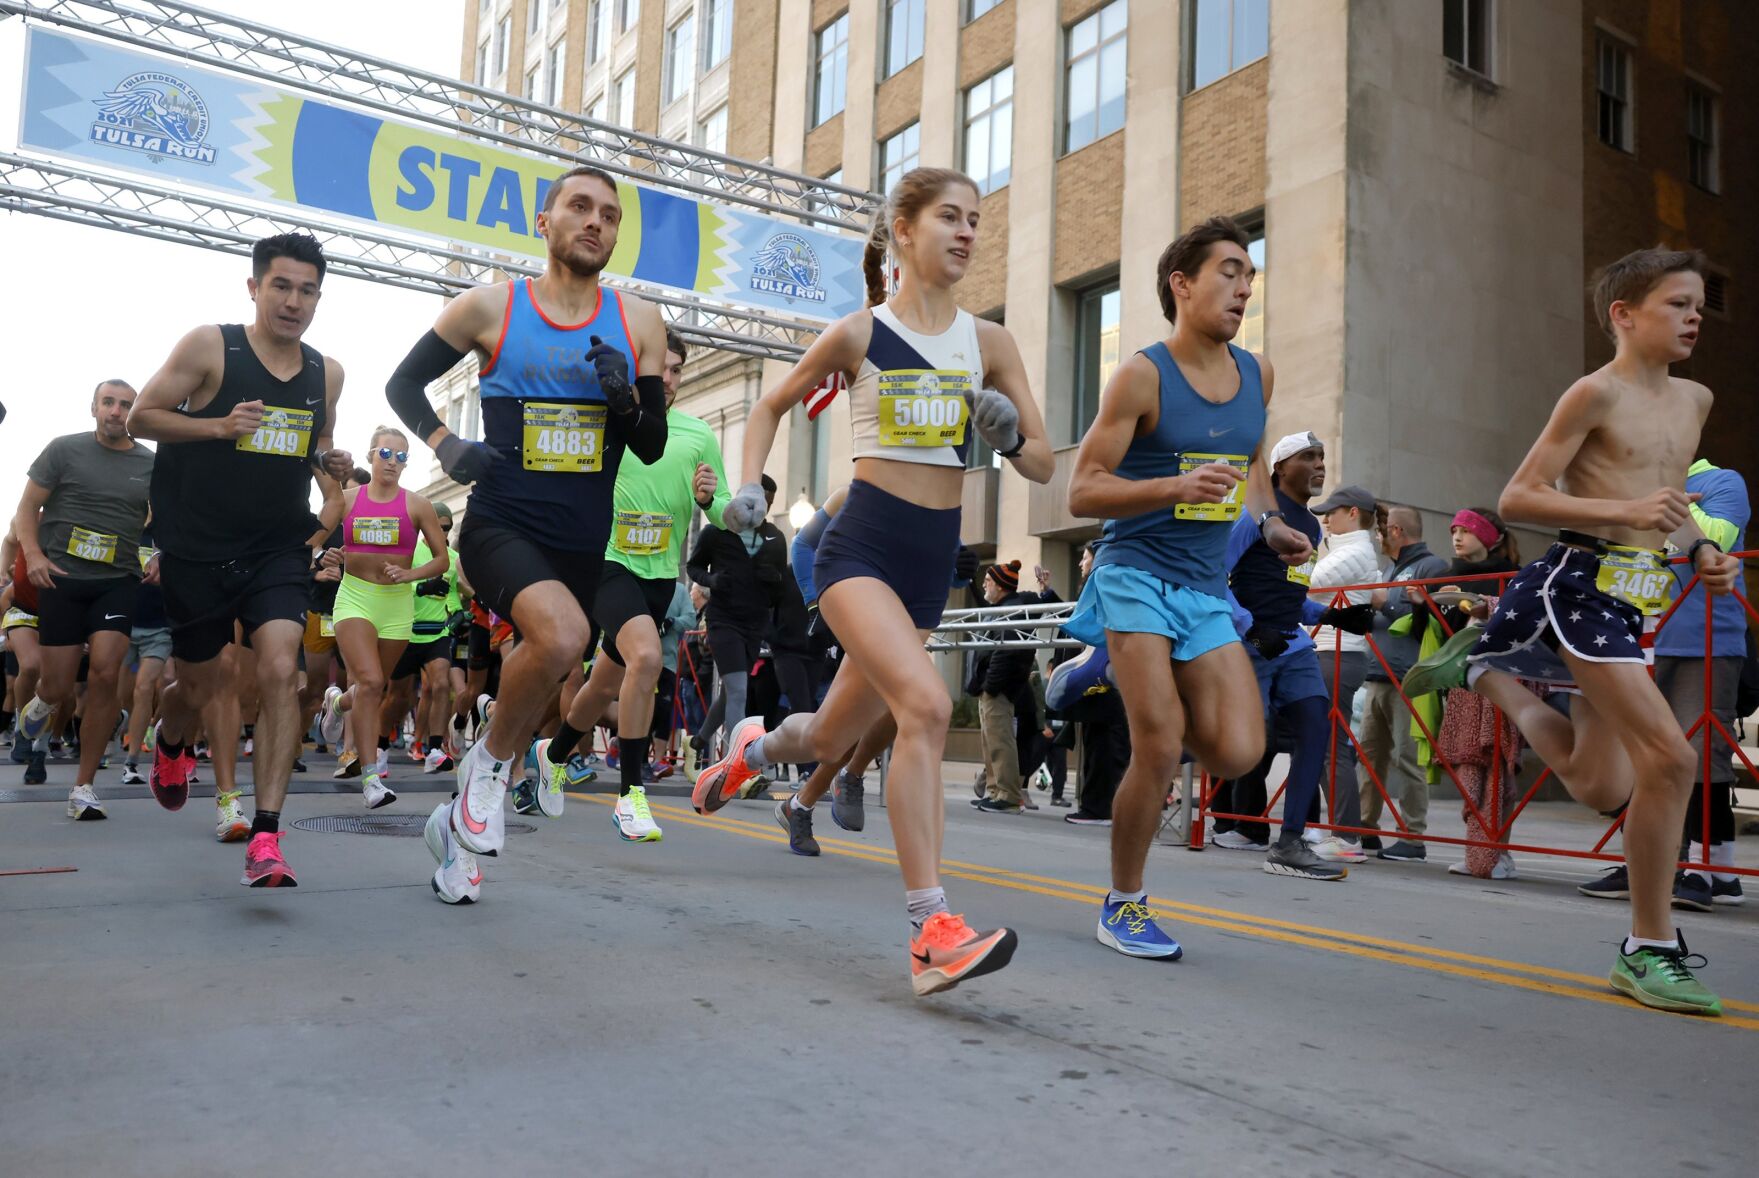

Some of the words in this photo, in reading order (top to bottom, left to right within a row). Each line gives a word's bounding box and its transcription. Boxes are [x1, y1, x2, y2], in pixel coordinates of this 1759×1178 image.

[122, 74, 146, 90] TULSA
[147, 74, 187, 91] FEDERAL
[188, 90, 207, 118] CREDIT
[98, 112, 134, 129] 2021
[193, 118, 208, 142] UNION
[94, 125, 162, 152] TULSA
[166, 140, 216, 163] RUN
[396, 145, 555, 239] STA
[753, 266, 777, 277] 2021
[752, 277, 793, 295] TULSA
[796, 286, 826, 301] RUN
[894, 398, 961, 427] 5000
[250, 428, 298, 454] 4749
[536, 429, 596, 456] 4883
[939, 430, 957, 438] BEER
[360, 530, 392, 543] 4085
[626, 528, 662, 545] 4107
[75, 543, 108, 561] 4207
[1609, 570, 1669, 600] 3463
